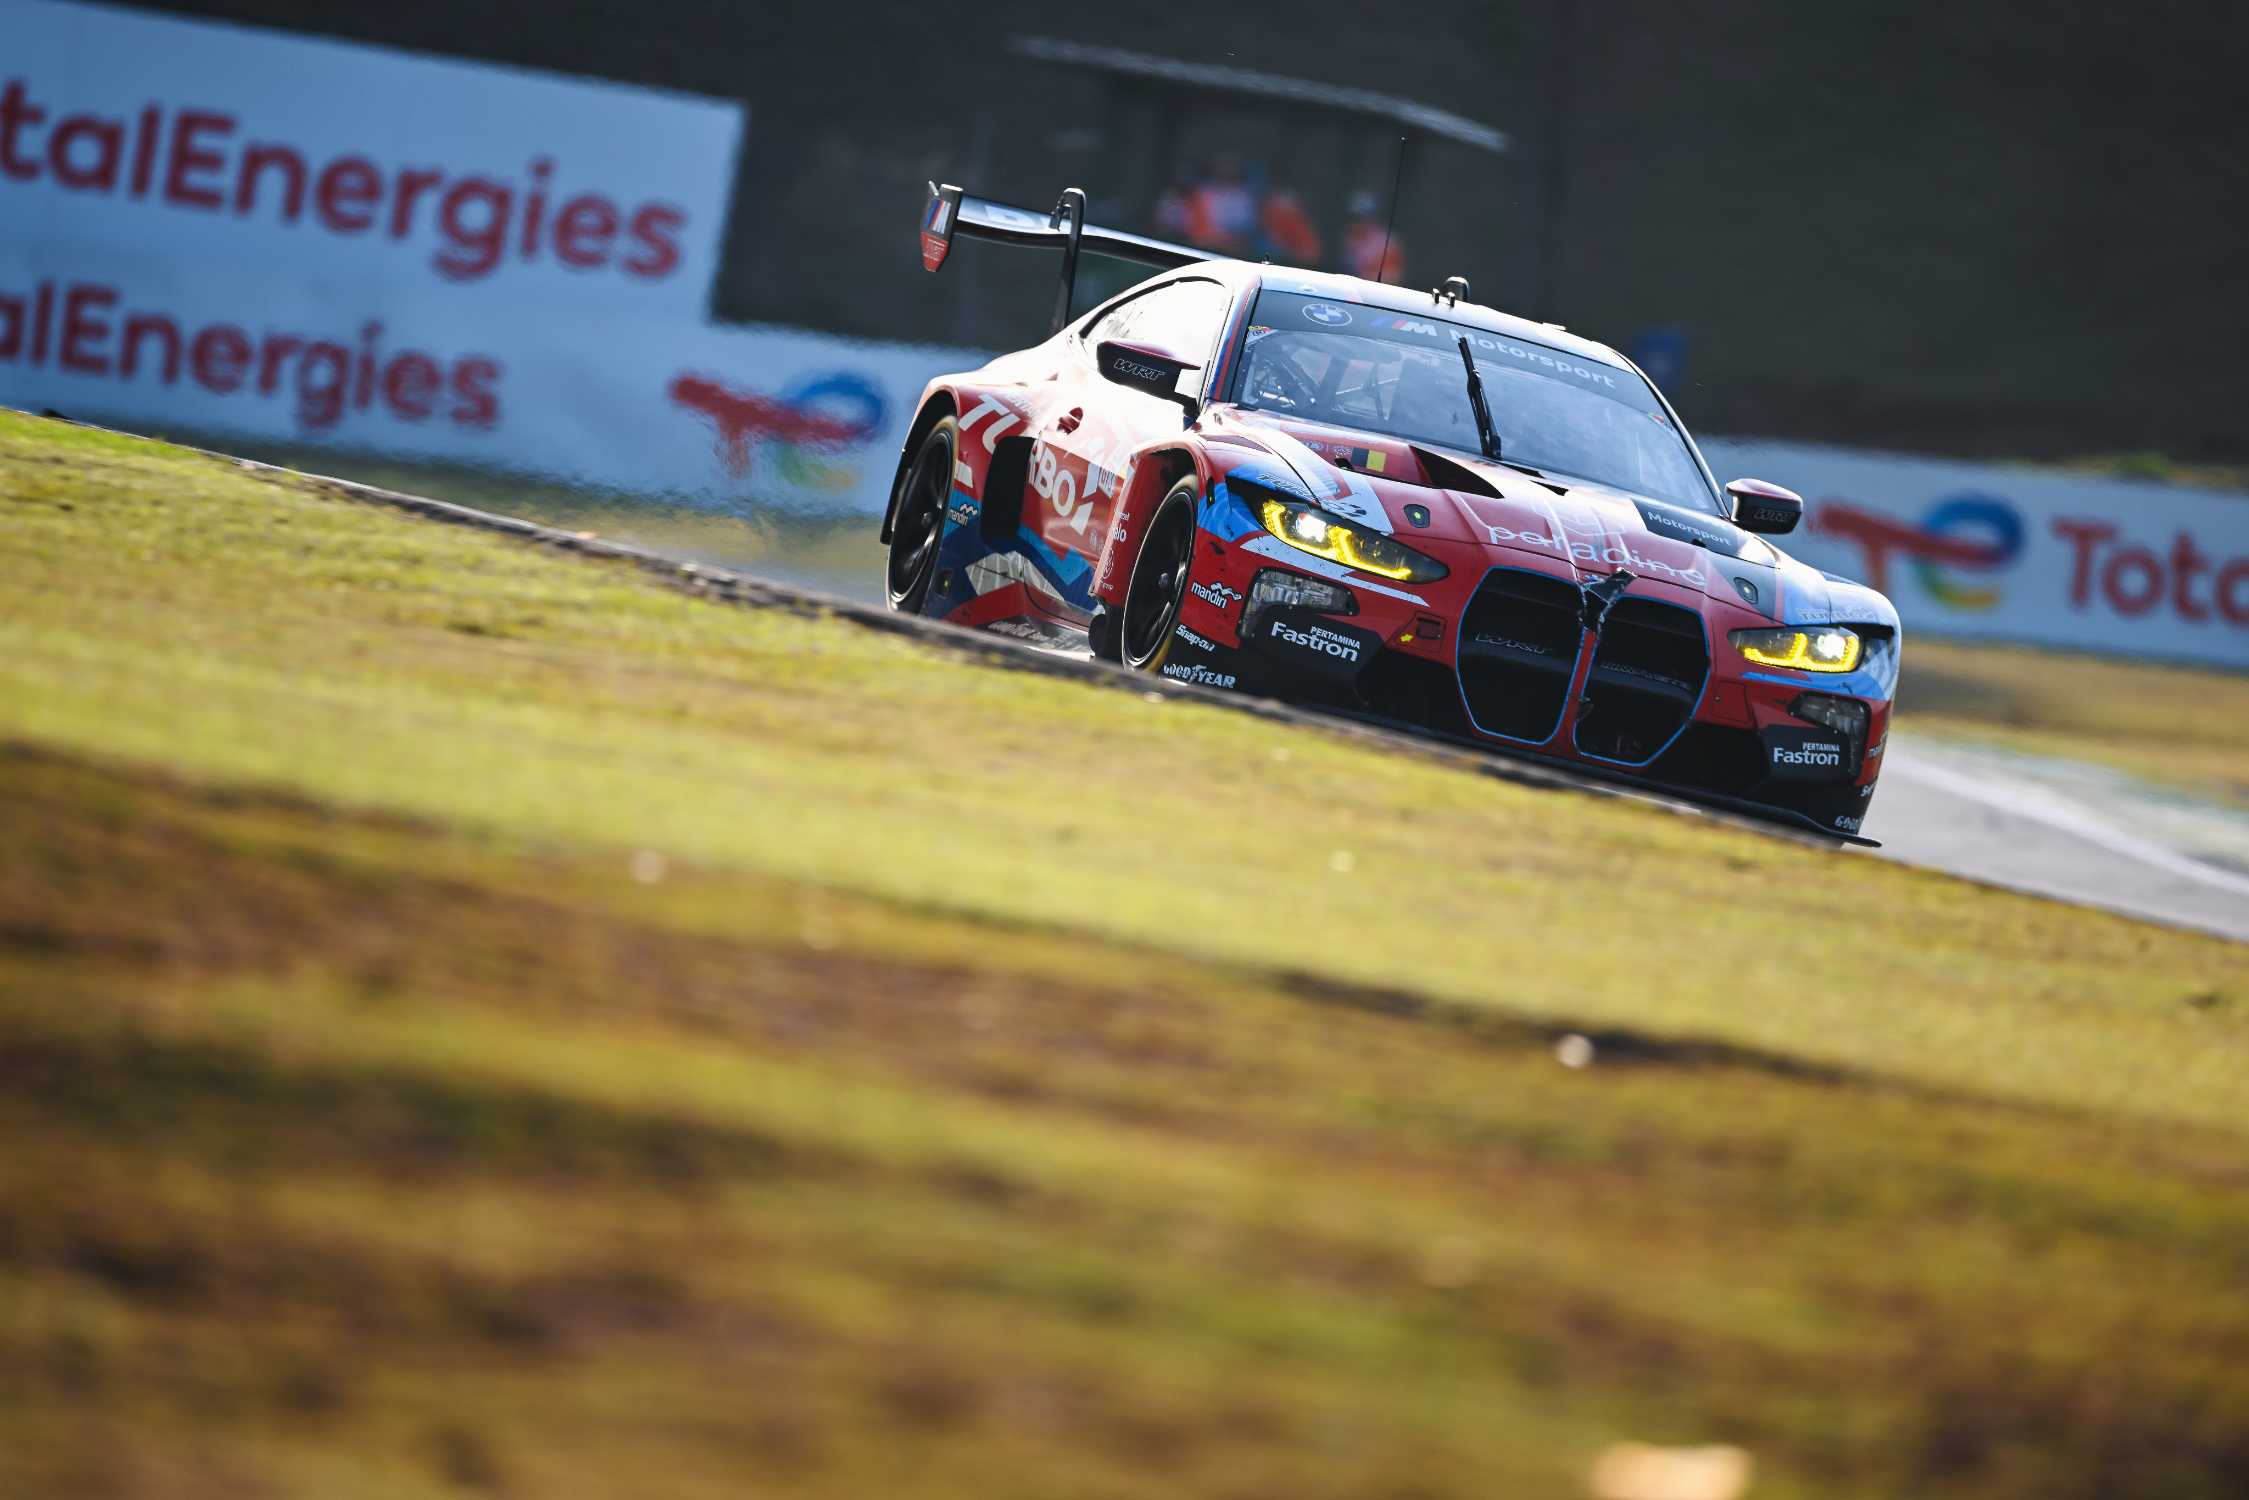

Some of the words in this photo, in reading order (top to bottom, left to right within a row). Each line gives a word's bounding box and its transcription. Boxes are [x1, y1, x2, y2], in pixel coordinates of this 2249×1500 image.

[1450, 330, 1616, 389] Motorsport
[1648, 510, 1731, 547] Motorsport
[1190, 582, 1228, 609] mandiri
[1271, 621, 1358, 663] Fastron
[1310, 626, 1361, 650] PERTAMINA
[1773, 747, 1840, 766] Fastron
[1802, 741, 1840, 752] PERTAMINA
